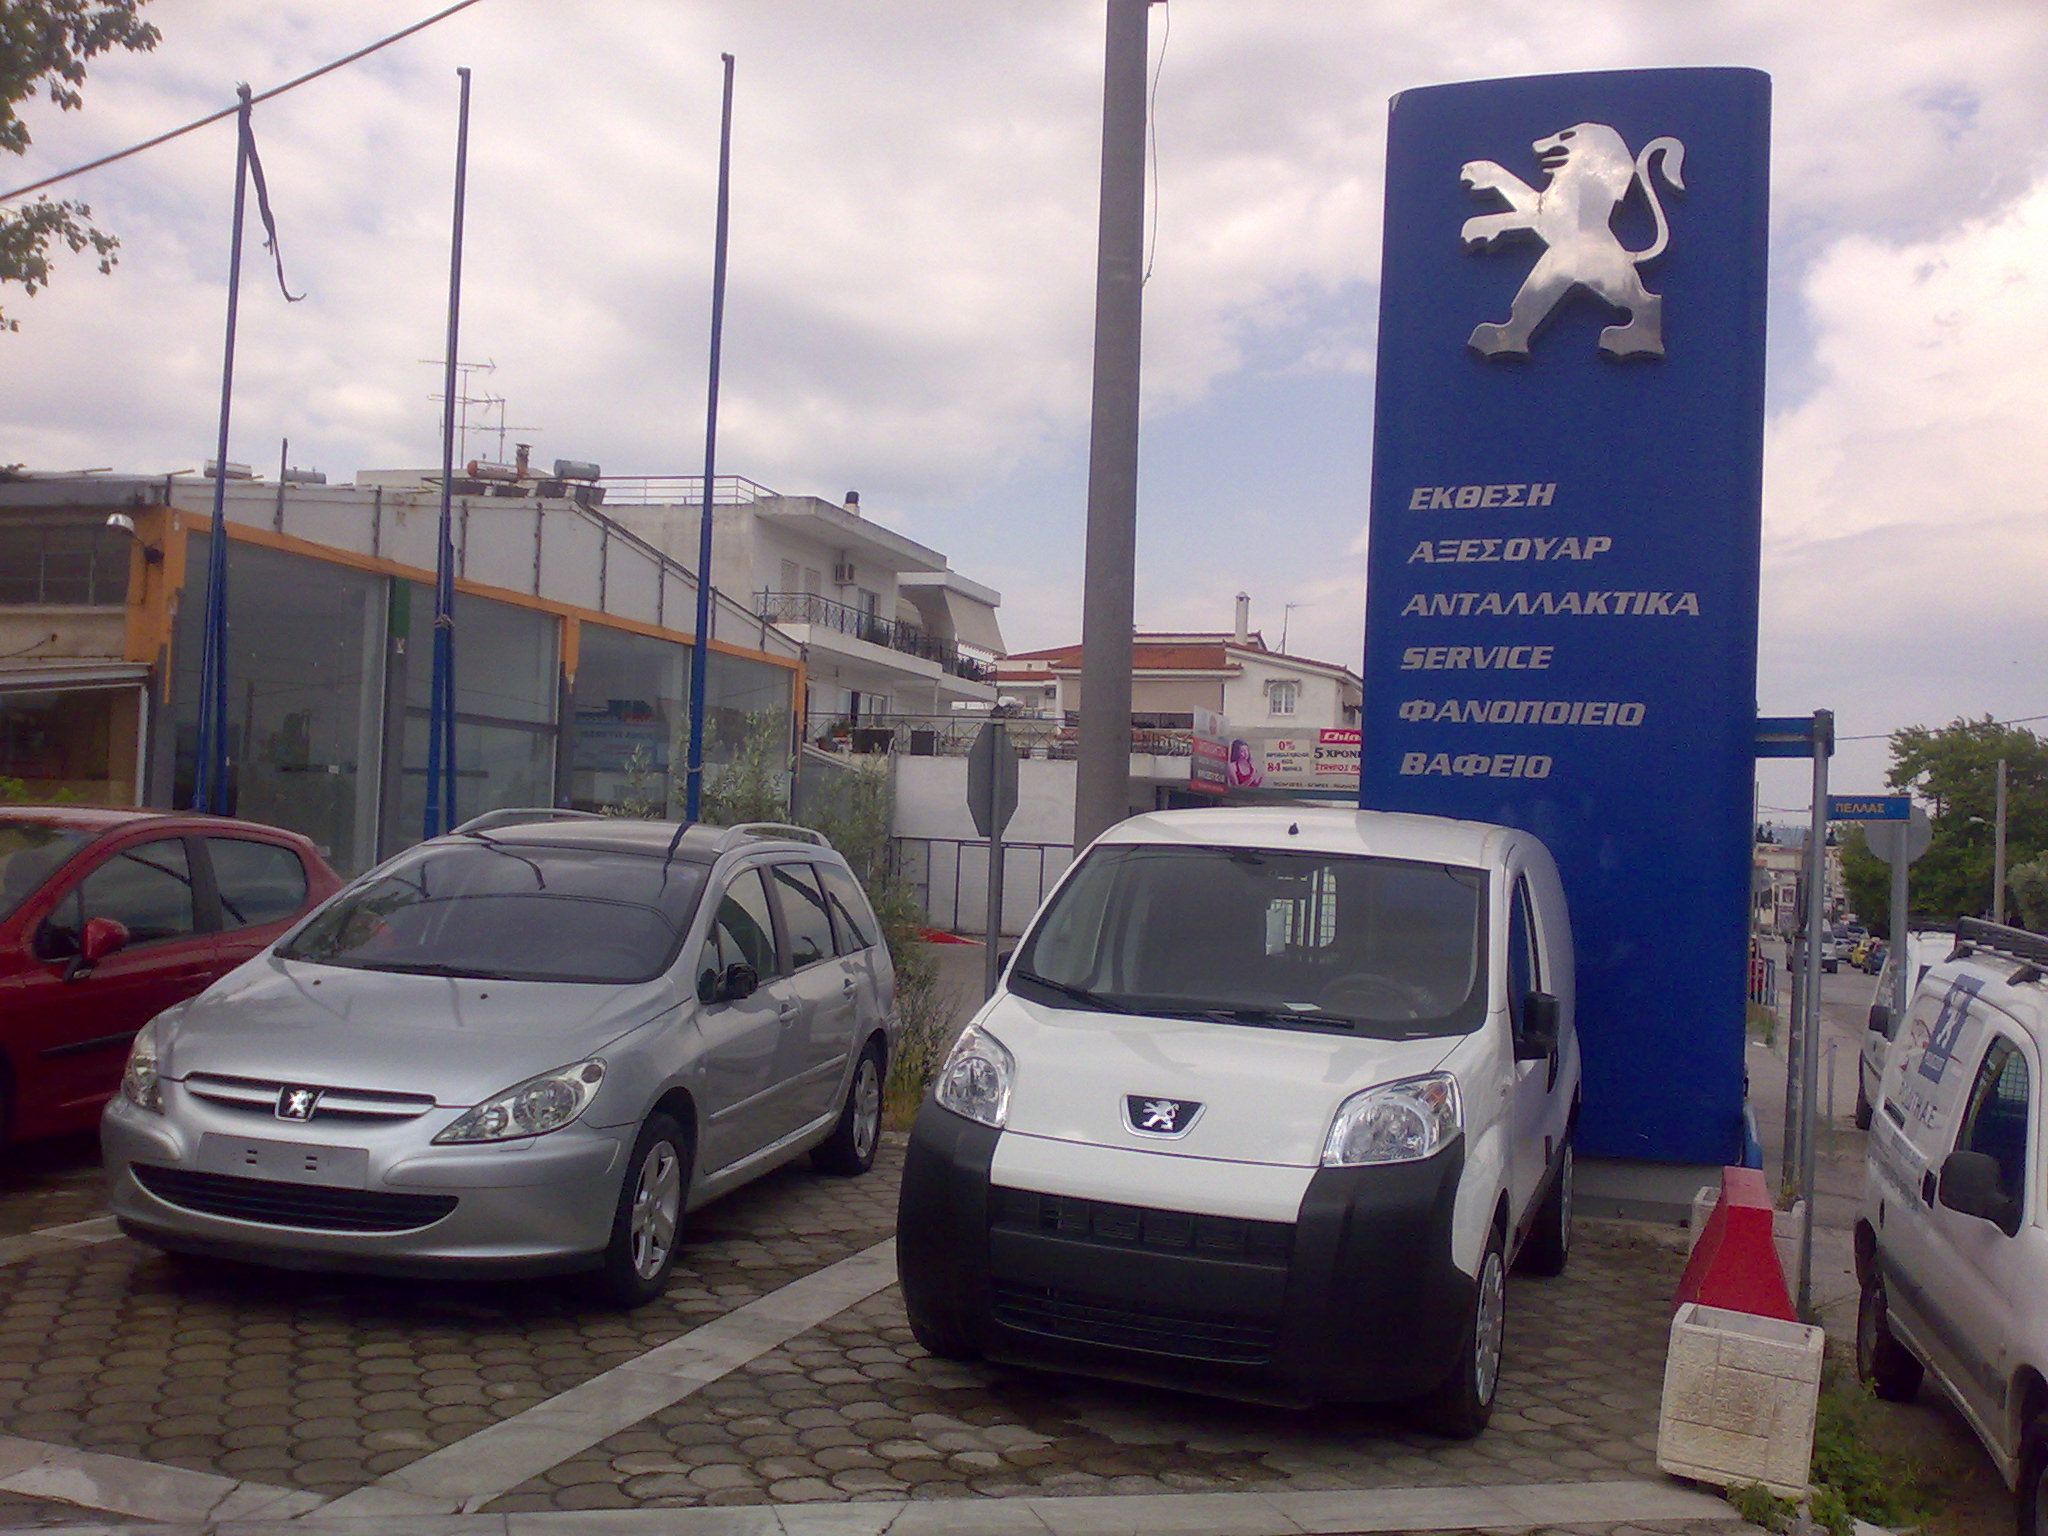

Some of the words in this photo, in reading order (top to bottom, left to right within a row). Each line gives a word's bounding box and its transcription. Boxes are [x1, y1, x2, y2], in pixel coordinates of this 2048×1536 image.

[1408, 483, 1557, 510] ΕΚΘΕΣΗ
[1407, 536, 1612, 563] ΑΞΕΣΟΥΑΡ
[1401, 591, 1700, 616] ΑΝΤΑΛΛΑΚΤΙΚΑ
[1401, 646, 1554, 670] SERVICE
[1399, 699, 1646, 726] ΦΑΝΟΠΟΙΕΙΟ
[1314, 747, 1324, 759] 5
[1400, 752, 1552, 779] ΒΑΦΕΙΟ
[1835, 802, 1886, 814] ΠΕΛΛΑΣ
